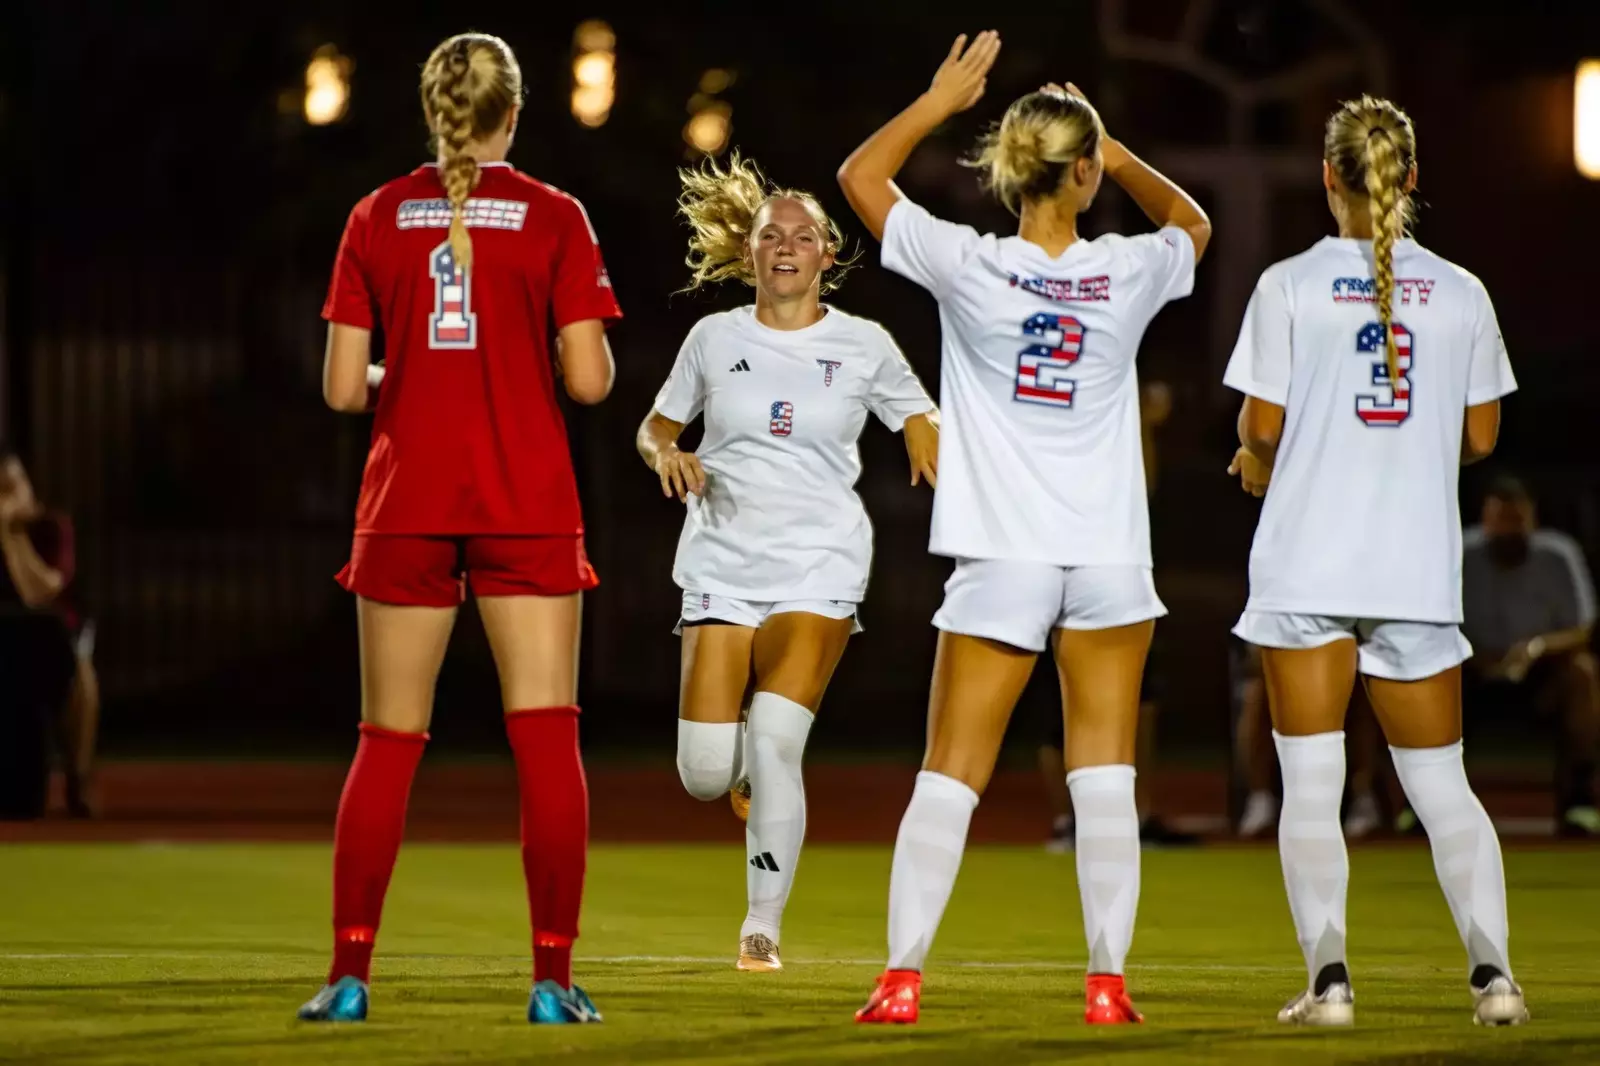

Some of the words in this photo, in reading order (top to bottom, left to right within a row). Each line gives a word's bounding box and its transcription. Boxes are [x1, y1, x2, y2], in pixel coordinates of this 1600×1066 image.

[428, 240, 477, 349] 1
[1332, 277, 1435, 305] CROTY
[1013, 312, 1088, 408] 2
[1355, 320, 1413, 428] 3
[769, 400, 793, 437] 8
